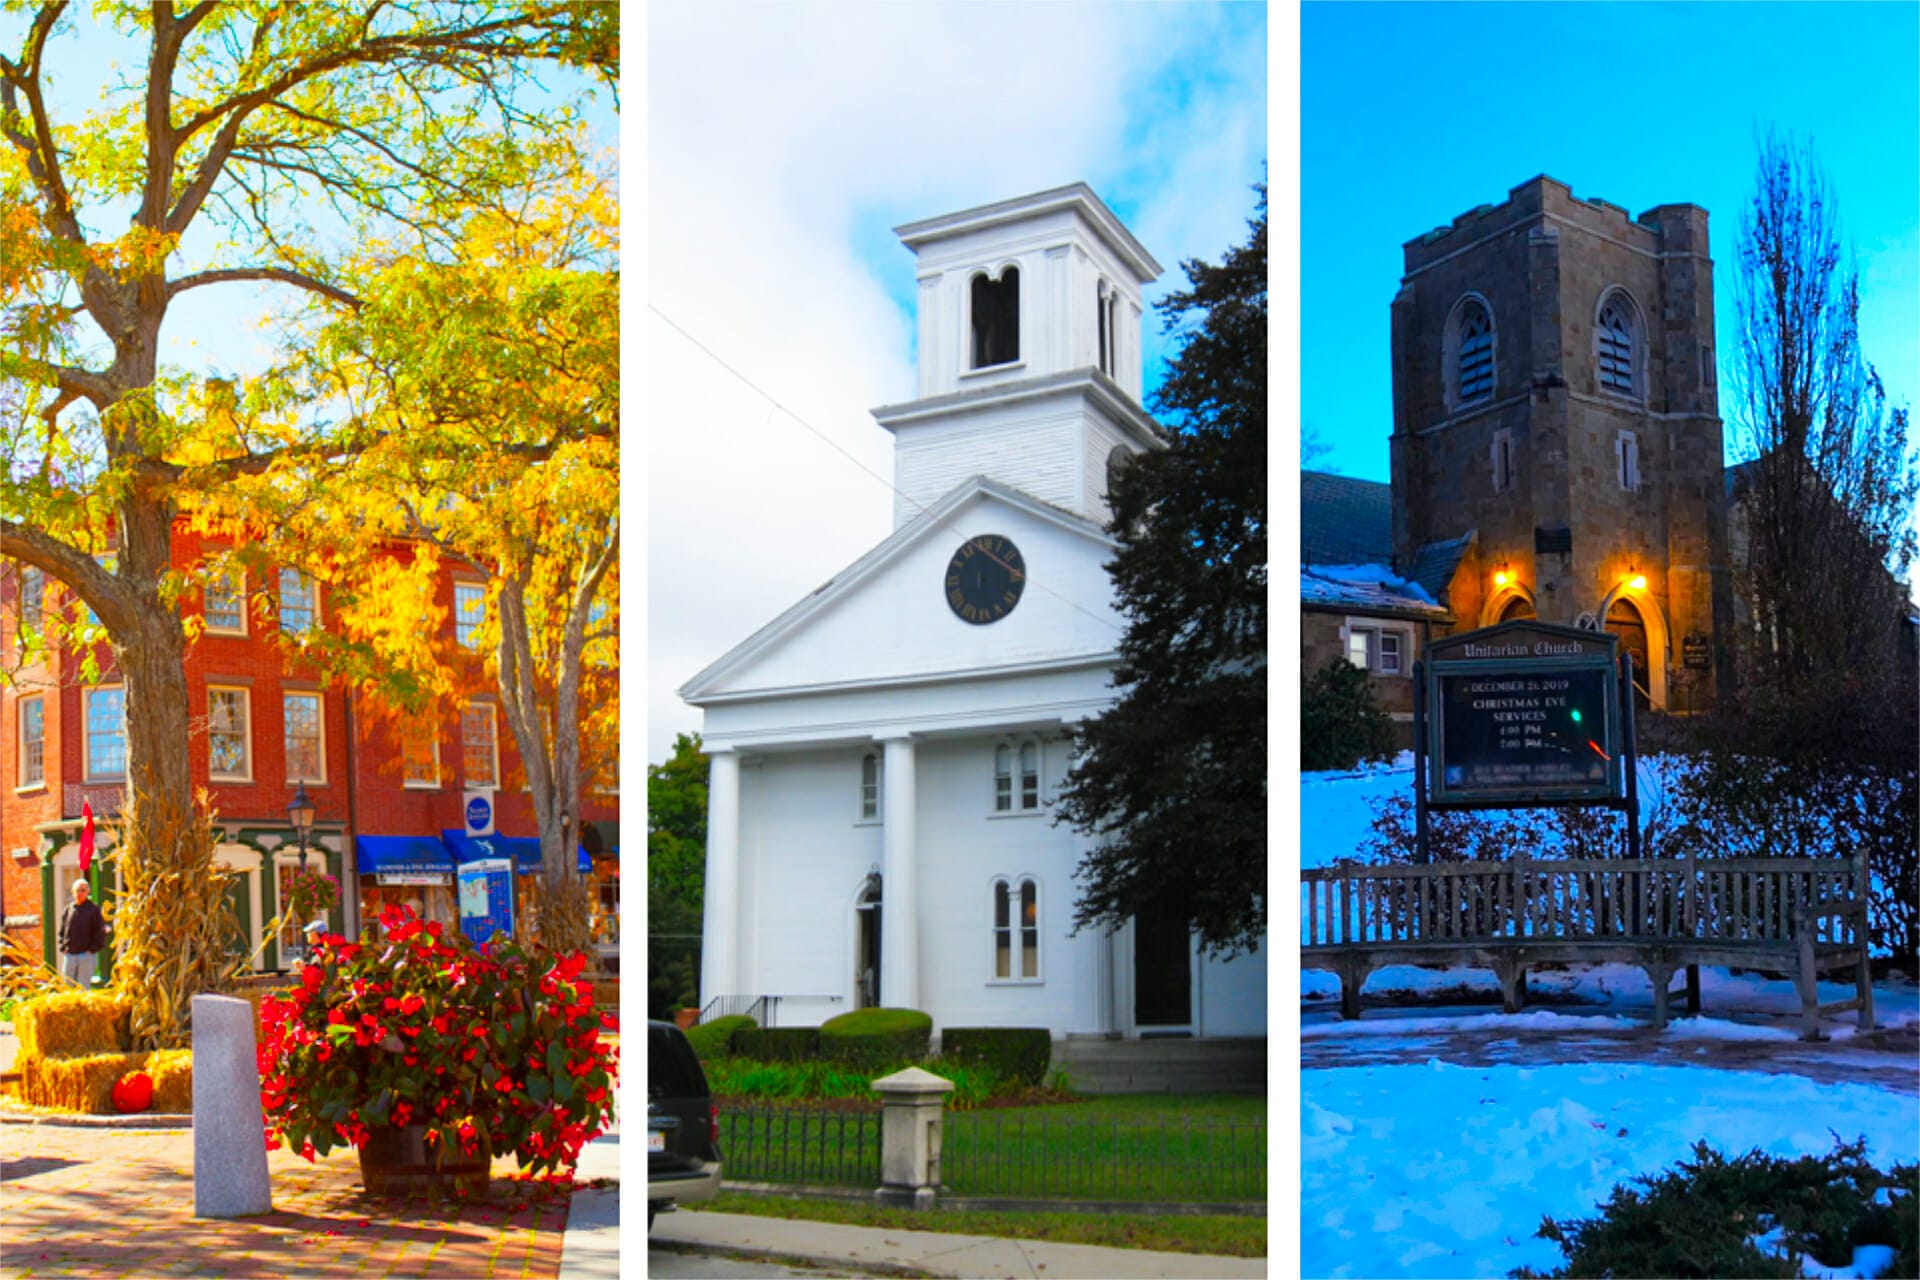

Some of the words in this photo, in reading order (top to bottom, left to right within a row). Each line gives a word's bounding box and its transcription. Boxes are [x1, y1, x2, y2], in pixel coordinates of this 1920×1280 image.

[1464, 643, 1529, 657] Unitarian
[1533, 640, 1584, 656] Church
[1472, 698, 1540, 709] CHRISTMAS
[1545, 696, 1567, 707] EVE
[1493, 710, 1547, 722] SERVICES
